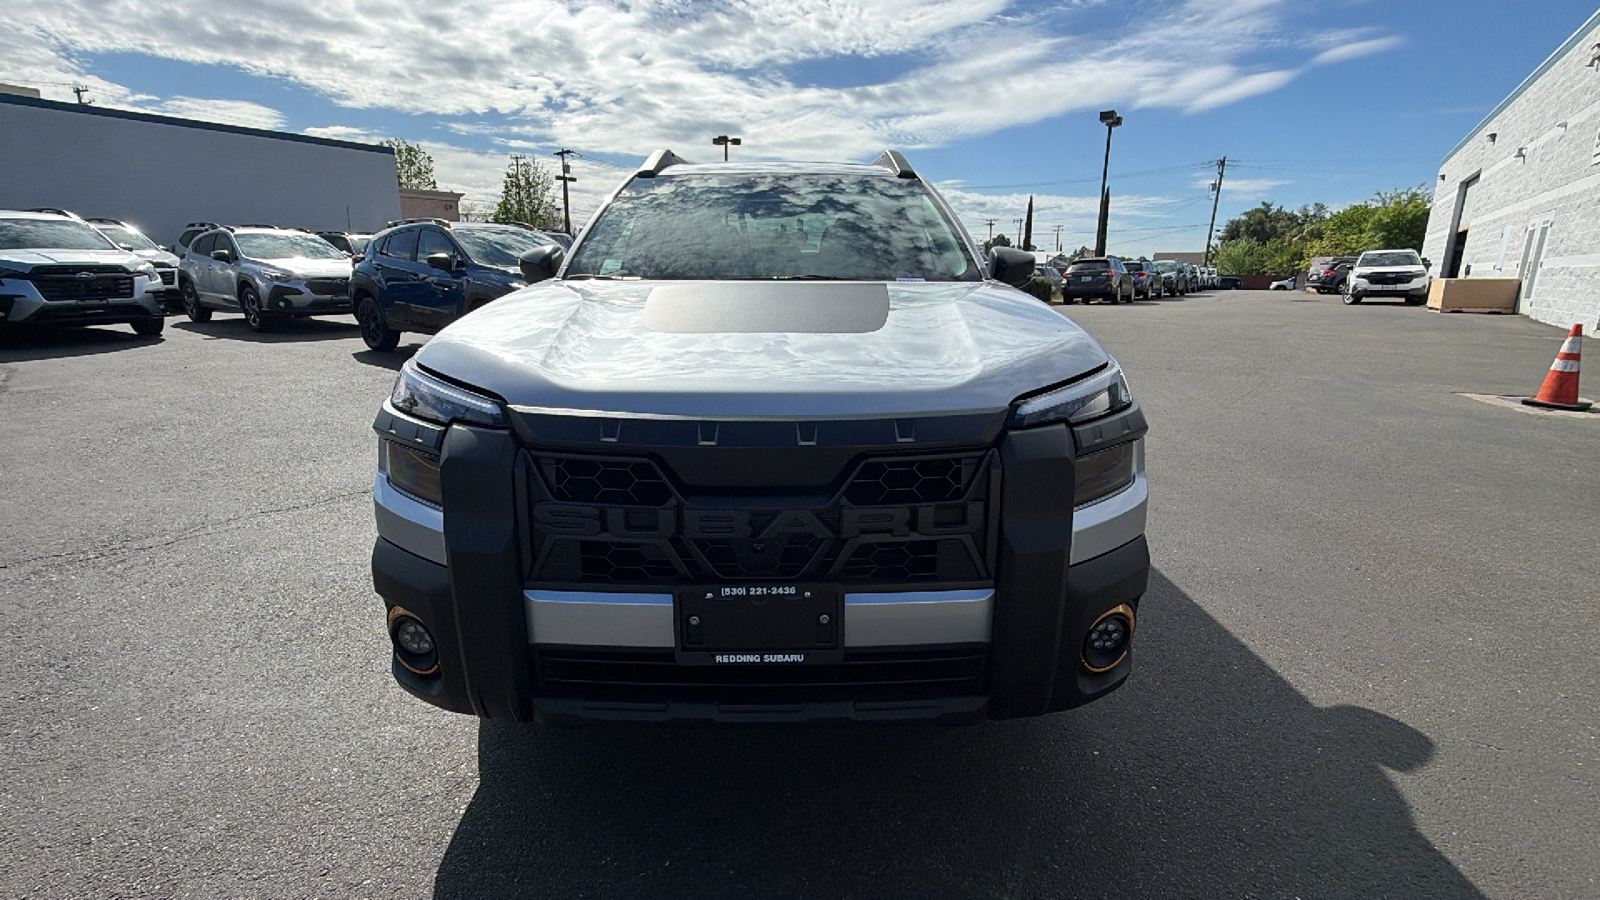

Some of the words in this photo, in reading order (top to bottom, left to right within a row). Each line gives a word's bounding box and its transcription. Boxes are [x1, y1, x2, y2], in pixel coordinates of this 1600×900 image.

[534, 501, 984, 539] SUBARU
[721, 587, 747, 597] (530)
[749, 586, 796, 595] 221-2436
[716, 654, 760, 663] REDDING
[763, 653, 804, 662] SUBARU
